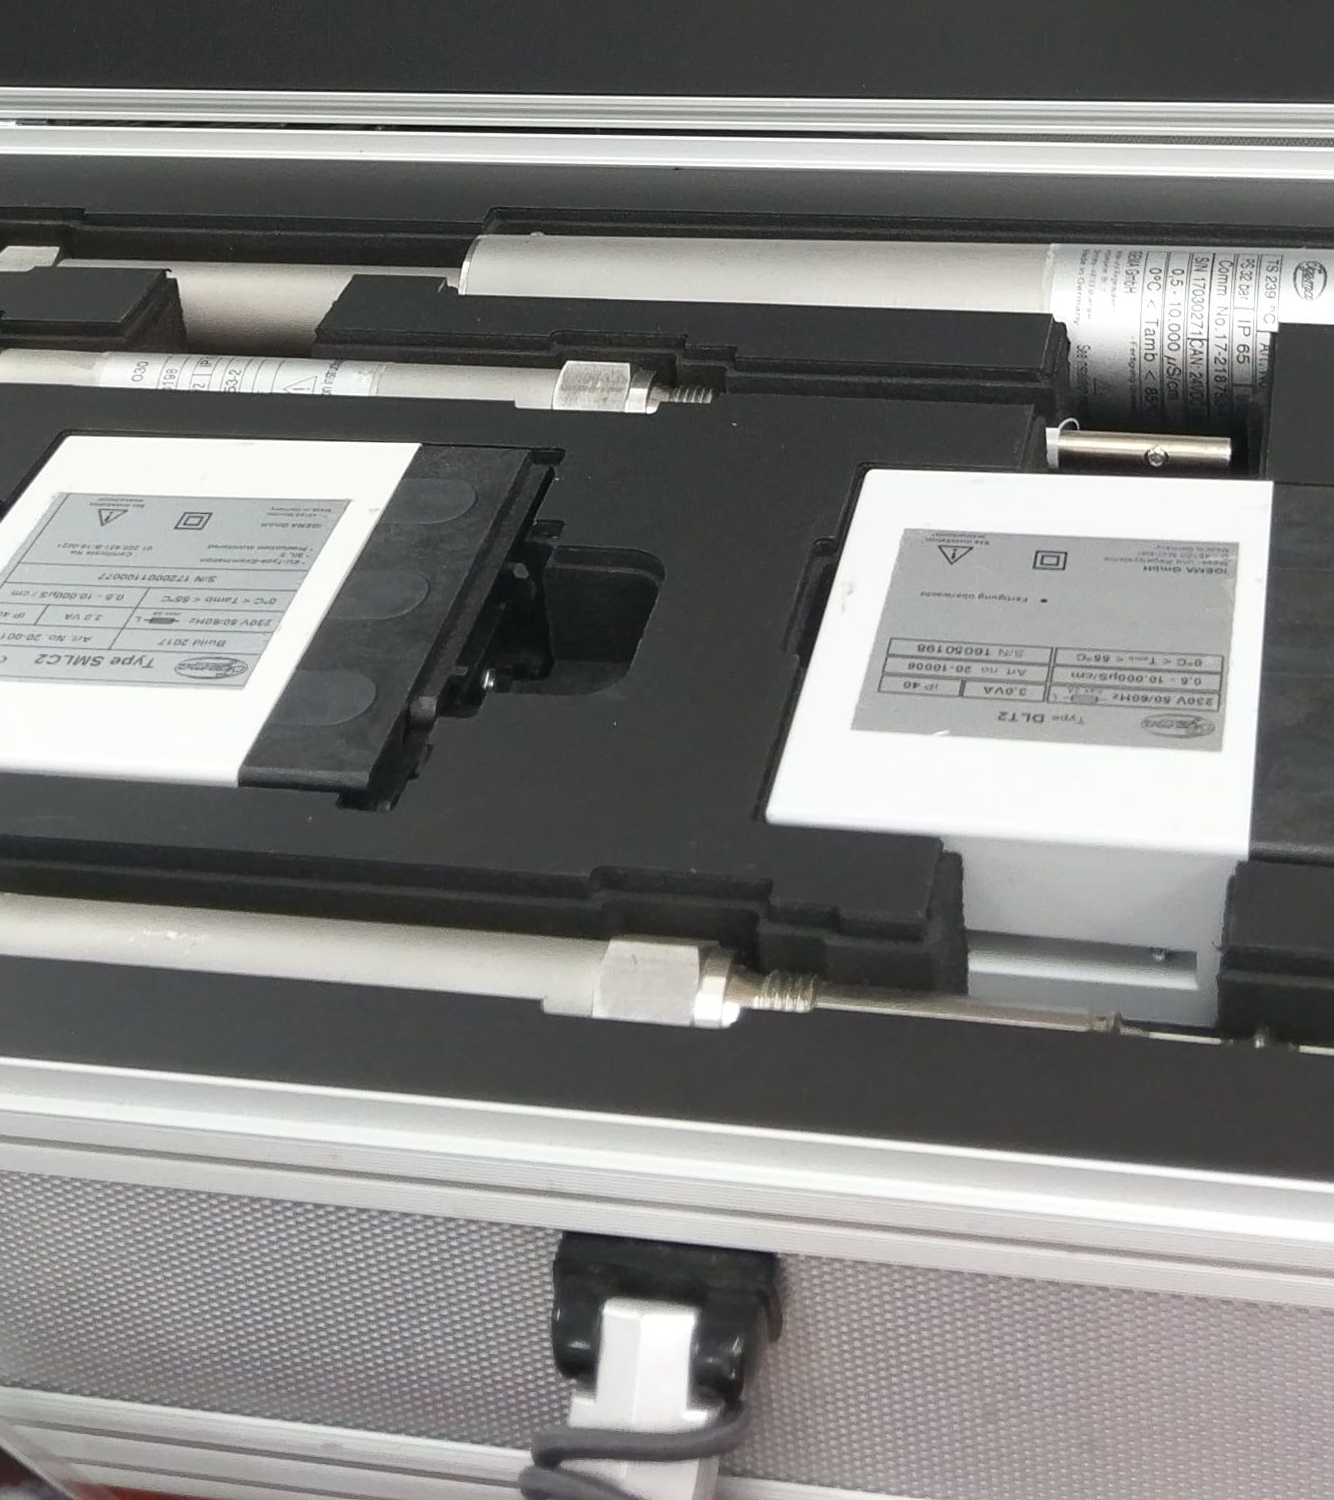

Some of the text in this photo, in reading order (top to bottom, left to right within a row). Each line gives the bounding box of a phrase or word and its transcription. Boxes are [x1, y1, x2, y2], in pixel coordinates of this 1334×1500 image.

[1266, 259, 1279, 273] TS
[1146, 266, 1162, 292] 0°C
[1265, 276, 1279, 299] 239
[1190, 276, 1206, 338] 17030271
[1167, 302, 1182, 352] 10.000
[1143, 317, 1158, 362] Tamb
[1236, 319, 1252, 365] IP 65
[158, 637, 227, 648] Build 2017
[34, 653, 155, 669] Type SMLC2
[903, 680, 921, 690] 40
[1175, 695, 1214, 707] 230V
[998, 711, 1045, 724] DLT2
